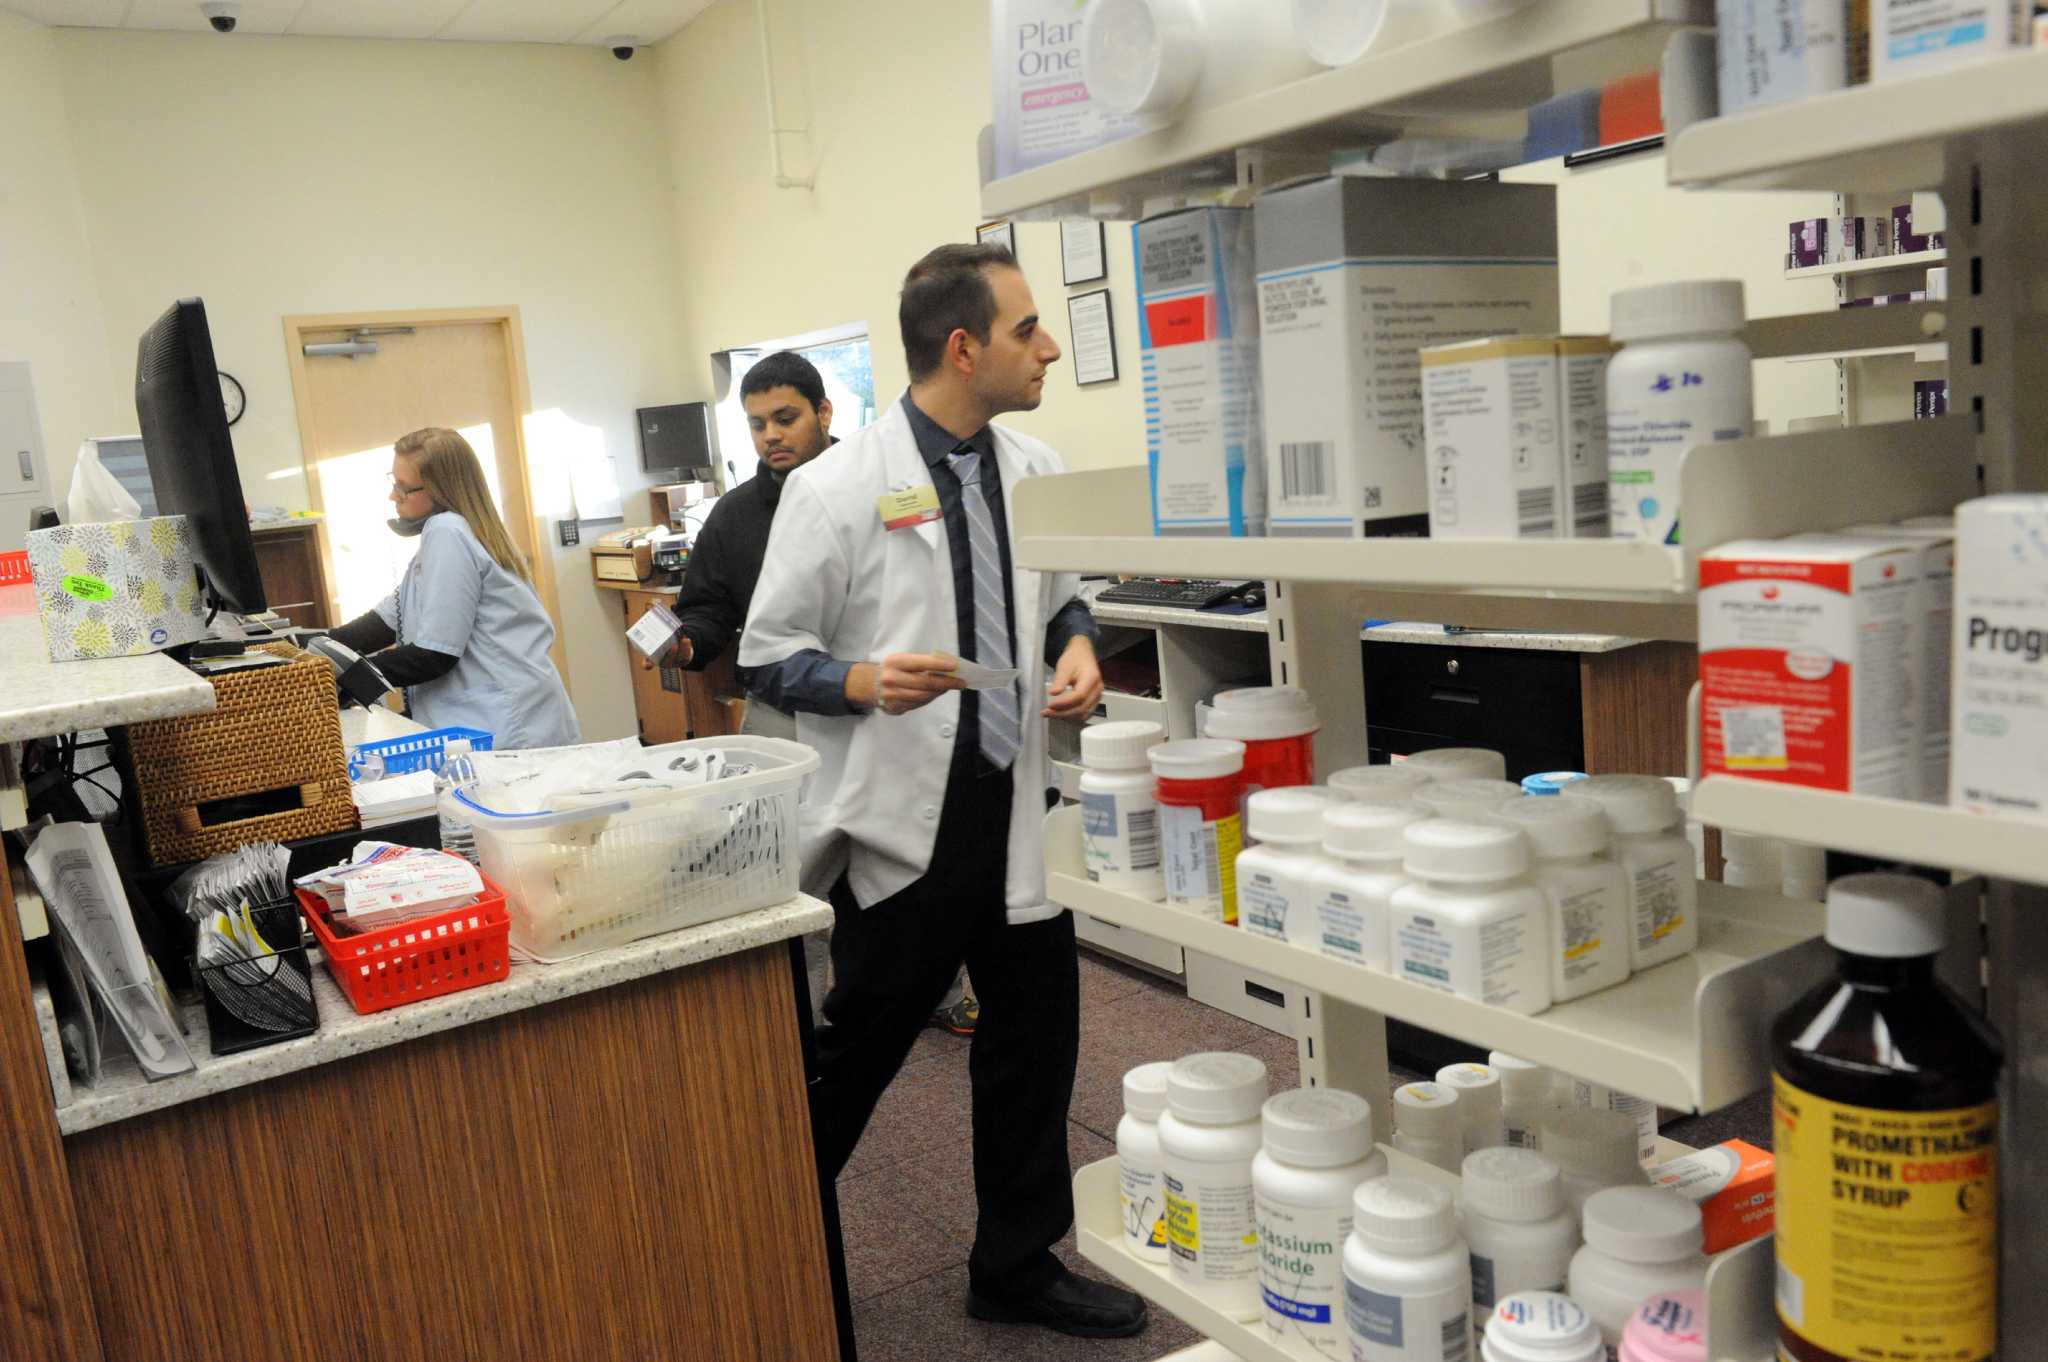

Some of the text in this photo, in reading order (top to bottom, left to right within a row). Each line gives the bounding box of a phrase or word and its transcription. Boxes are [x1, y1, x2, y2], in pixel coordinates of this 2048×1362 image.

[1018, 48, 1082, 77] One
[1968, 615, 2048, 663] Prog
[1833, 1153, 1893, 1181] WITH
[1832, 1179, 1910, 1209] SYRUP
[1257, 1221, 1333, 1255] tassium
[1259, 1244, 1315, 1276] loride
